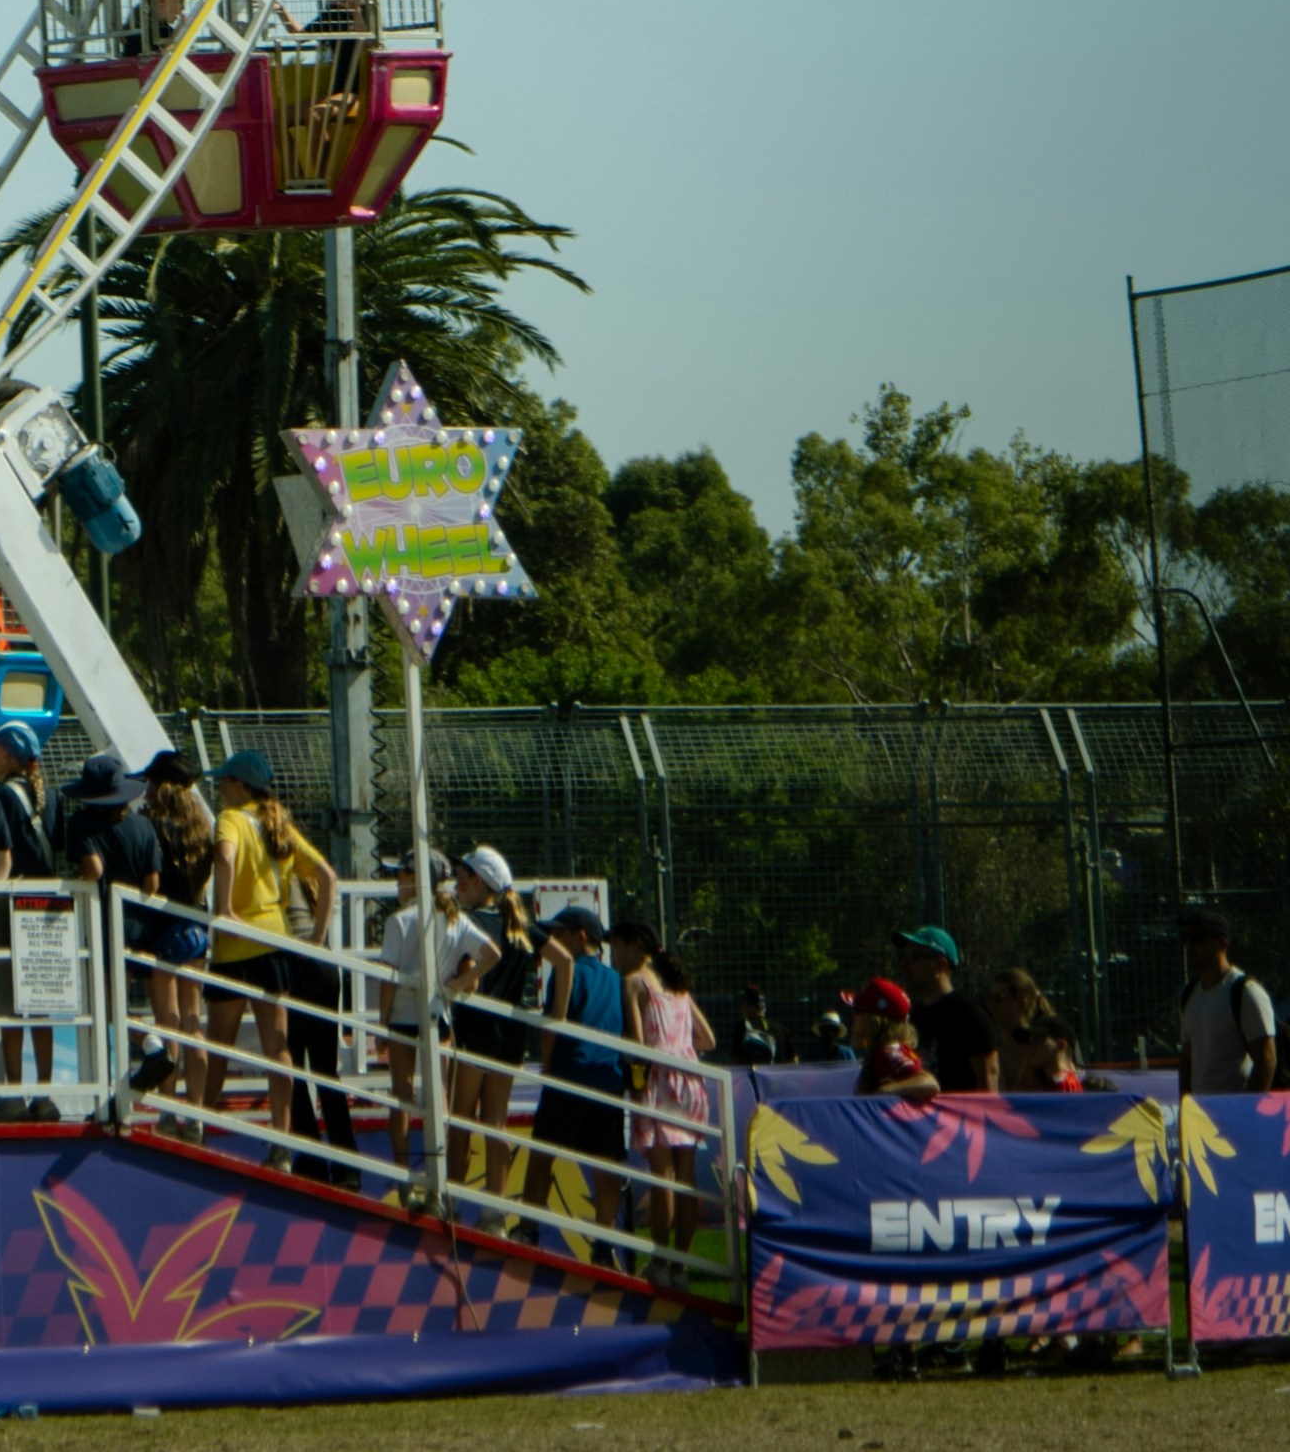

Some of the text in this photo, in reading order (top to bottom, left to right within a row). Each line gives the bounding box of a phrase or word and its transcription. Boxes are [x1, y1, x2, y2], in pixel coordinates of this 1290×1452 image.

[340, 441, 486, 503] EURO
[341, 523, 513, 586] WHEEL
[869, 1197, 1061, 1252] ENTRY
